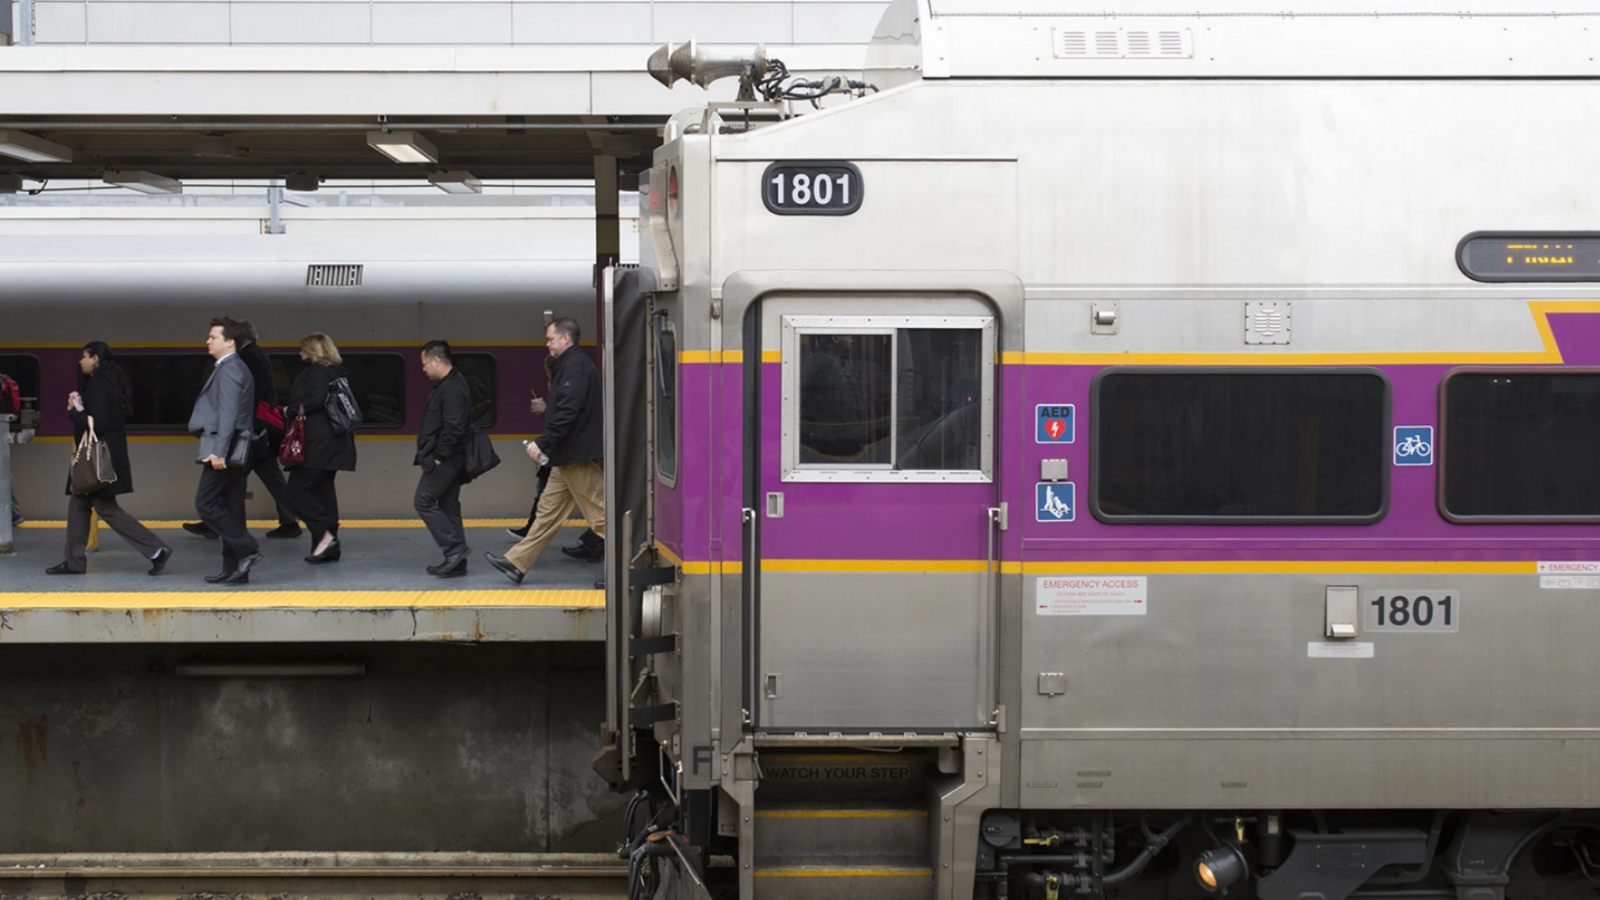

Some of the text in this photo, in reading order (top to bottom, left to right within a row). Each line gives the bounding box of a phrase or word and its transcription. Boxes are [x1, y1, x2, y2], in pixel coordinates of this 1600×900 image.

[771, 173, 849, 205] 1801
[1041, 406, 1070, 418] AED
[1548, 563, 1598, 572] EMERGENCY
[1043, 580, 1139, 588] EMERGENCY ACCESS
[1371, 595, 1451, 626] 1801
[693, 746, 715, 775] F
[766, 767, 909, 780] WATCH YOUR STEP
